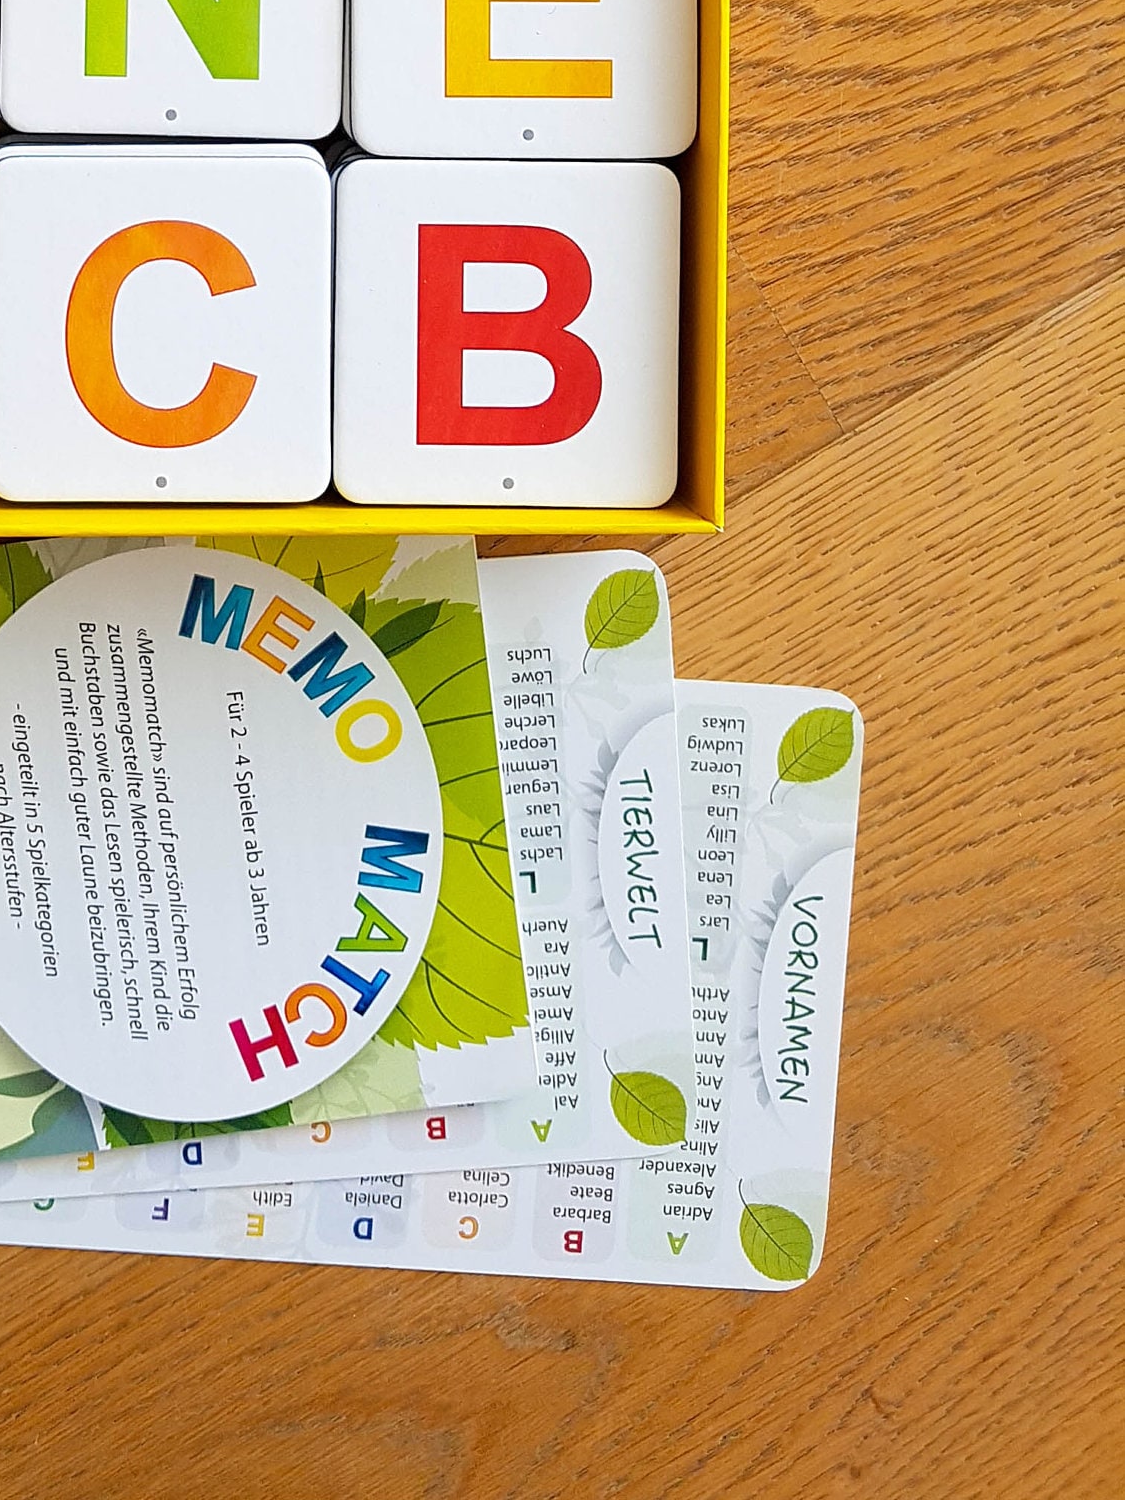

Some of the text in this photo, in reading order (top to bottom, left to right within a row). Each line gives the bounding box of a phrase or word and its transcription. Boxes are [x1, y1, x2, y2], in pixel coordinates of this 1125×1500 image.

[65, 220, 257, 448] C
[417, 223, 603, 446] B
[507, 648, 551, 664] Luchs
[511, 670, 552, 684] Löwe
[226, 690, 244, 722] Für
[503, 693, 554, 708] Libelle
[505, 715, 555, 731] Lerche
[702, 717, 745, 732] Lukas
[231, 726, 247, 739] 2
[687, 735, 743, 754] Ludwig
[12, 712, 38, 796] eingeteilt
[235, 755, 250, 767] 4
[691, 761, 741, 777] Lorenz
[153, 767, 174, 804] sind
[712, 785, 740, 799] Lisa
[25, 799, 41, 818] in
[234, 771, 258, 839] Spieler
[526, 803, 560, 816] Laus
[707, 806, 738, 821] Lina
[27, 823, 43, 835] 5
[78, 621, 148, 1040] Buchstaben sowie das Lesen spielerisch, schnell
[106, 623, 175, 1032] zusammengestellte Methoden, Ihrem Kind die
[158, 808, 179, 841] auf
[178, 573, 430, 1082] MEMO MATCH
[520, 825, 562, 838] Lama
[54, 647, 114, 1027] und mit einfach guter Laune beizubringen.
[707, 825, 736, 843] Lilly
[245, 841, 264, 864] ab
[520, 847, 563, 862] Lachs
[620, 768, 662, 949] TIERWELT
[698, 850, 734, 865] Leon
[248, 868, 264, 879] 3
[519, 871, 537, 893] L
[698, 872, 733, 887] Lena
[25, 838, 59, 978] Spielkategorien
[159, 841, 189, 963] persönlichem
[706, 895, 731, 909] Lea
[251, 885, 271, 947] Jahren
[700, 916, 730, 931] Lars
[522, 918, 568, 936] Auerh
[544, 941, 569, 954] Ara
[692, 938, 708, 961] L
[178, 967, 200, 1020] Erfolg
[530, 985, 572, 999] Amse
[776, 896, 823, 1103] VORNAMEN
[534, 1007, 573, 1022] Amei
[545, 1051, 576, 1066] Affe
[555, 1095, 579, 1111] Aal
[311, 1121, 331, 1143] C
[426, 1116, 446, 1140] B
[531, 1119, 552, 1142] A
[183, 1142, 202, 1165] D
[547, 1163, 615, 1180] Benedikt
[639, 1160, 716, 1177] Alexander
[463, 1170, 510, 1185] Celina
[253, 1190, 292, 1207] Edith
[448, 1191, 509, 1208] Carlotta
[570, 1186, 613, 1201] Beate
[668, 1183, 714, 1199] Agnes
[345, 1192, 402, 1209] Daniela
[152, 1198, 169, 1221] F
[553, 1207, 611, 1223] Barbara
[663, 1204, 713, 1221] Adrian
[246, 1213, 265, 1237] E
[353, 1217, 373, 1240] D
[459, 1216, 479, 1239] C
[564, 1231, 583, 1253] B
[667, 1231, 689, 1255] A
